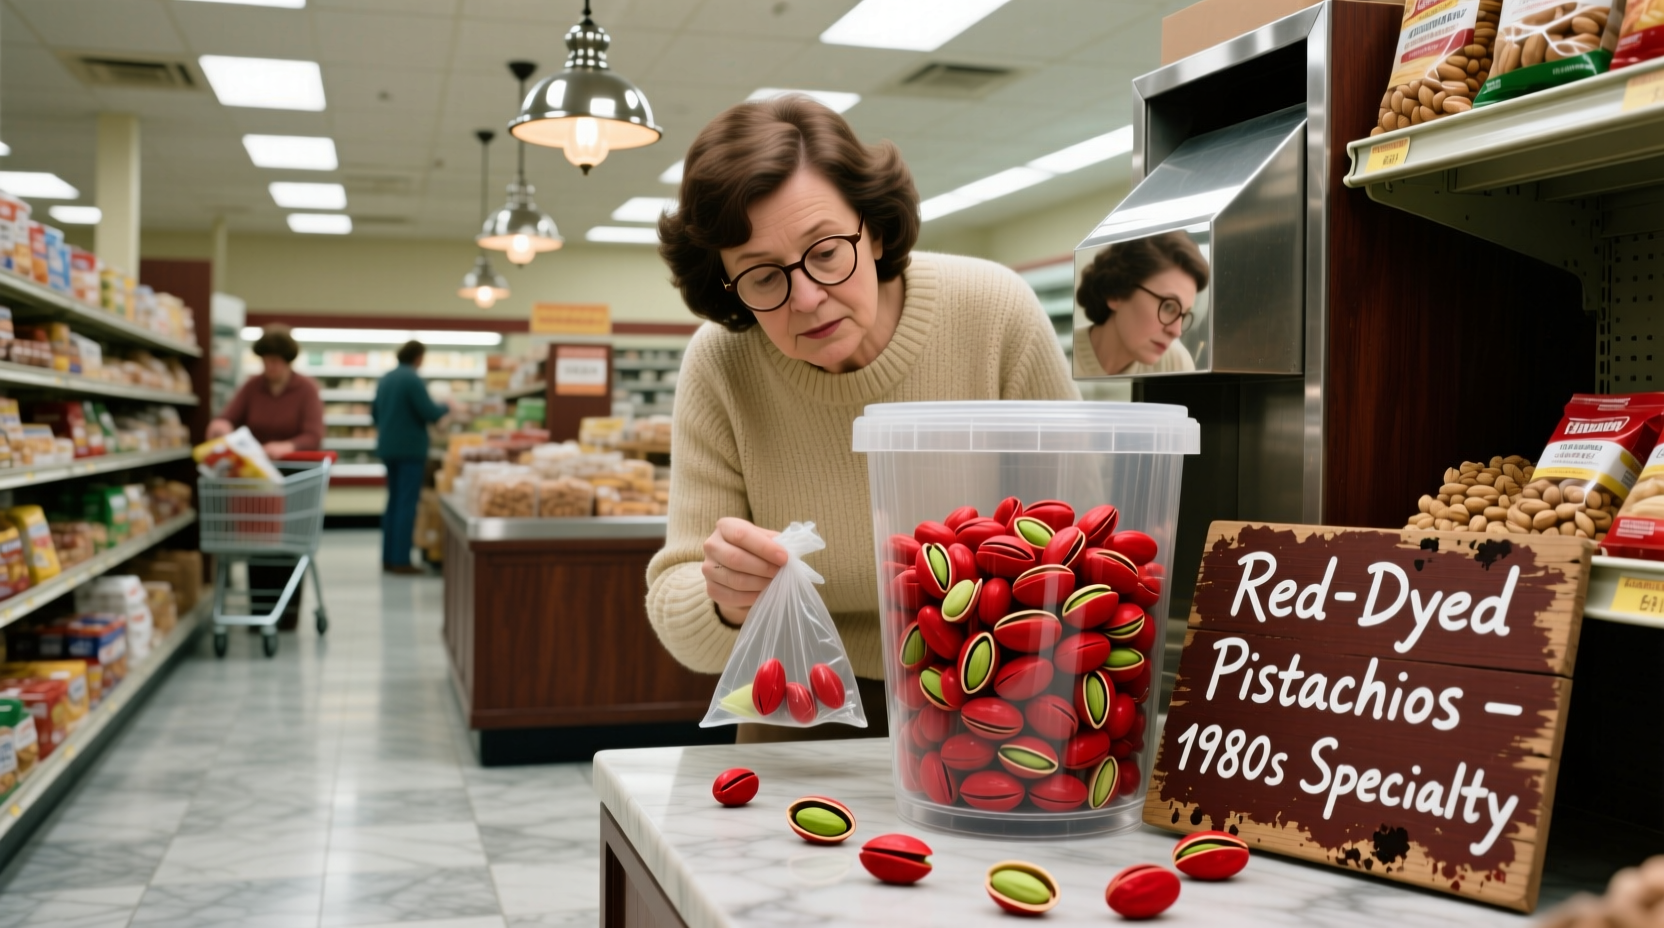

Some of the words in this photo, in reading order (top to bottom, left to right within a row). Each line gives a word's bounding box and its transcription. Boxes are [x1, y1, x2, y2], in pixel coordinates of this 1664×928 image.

[1230, 551, 1520, 655] Red-Dyed
[1205, 636, 1464, 732] Pistachios
[1177, 723, 1289, 787] 1980s
[1299, 736, 1520, 857] Specialty
